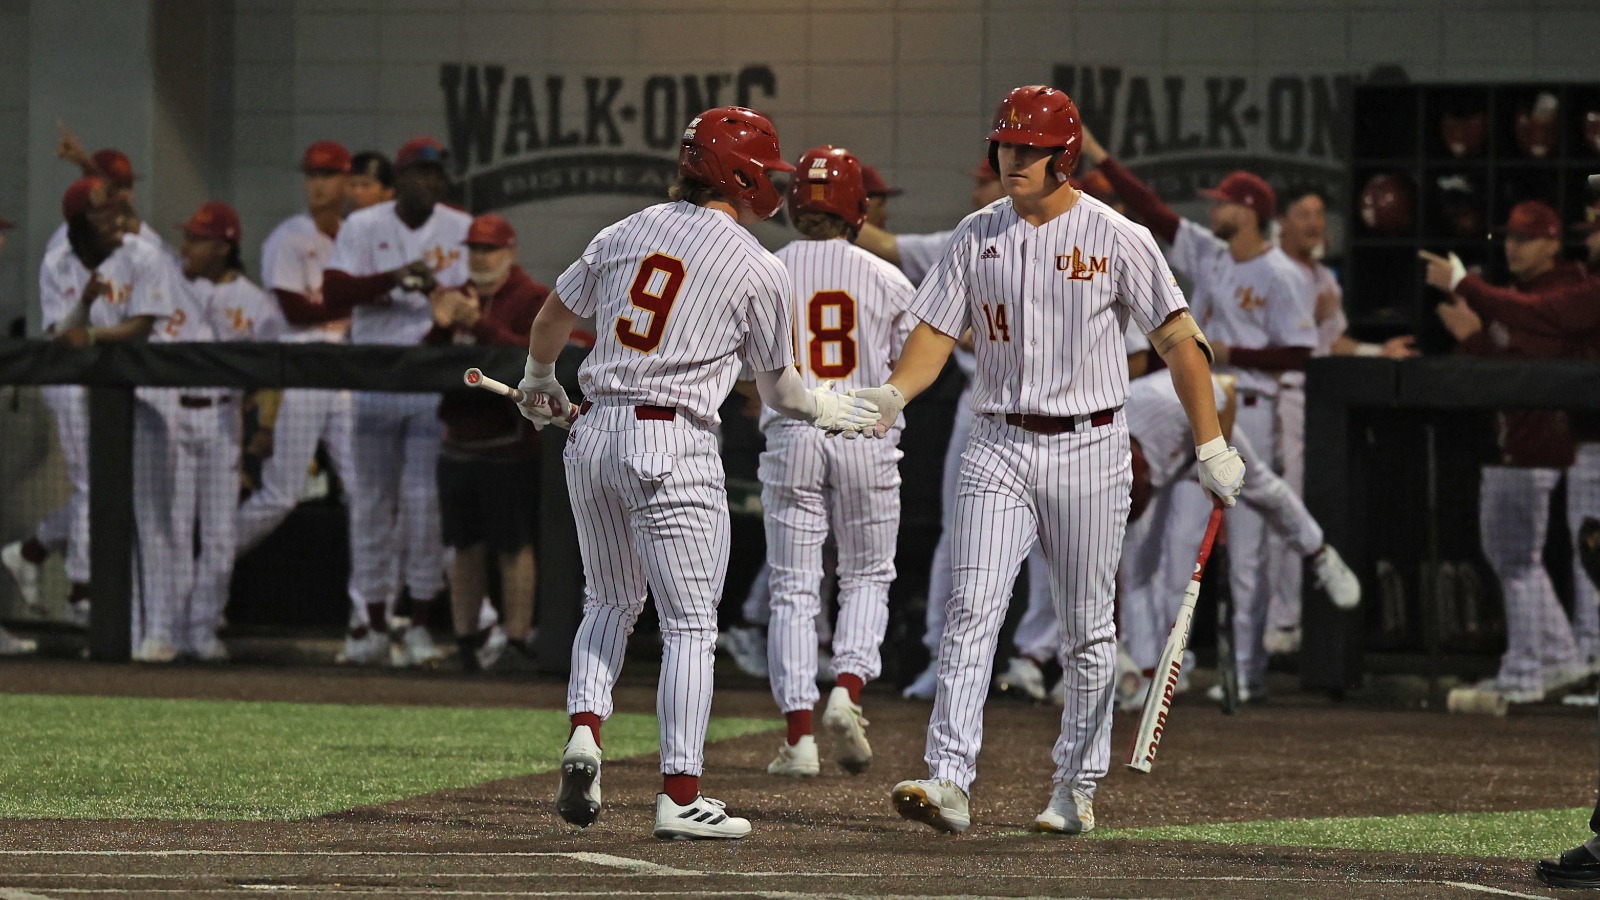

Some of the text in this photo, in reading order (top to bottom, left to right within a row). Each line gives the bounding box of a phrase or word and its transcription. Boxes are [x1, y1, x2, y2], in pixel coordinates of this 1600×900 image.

[1055, 243, 1108, 280] ULM
[614, 251, 688, 354] 9
[982, 302, 1011, 342] 14
